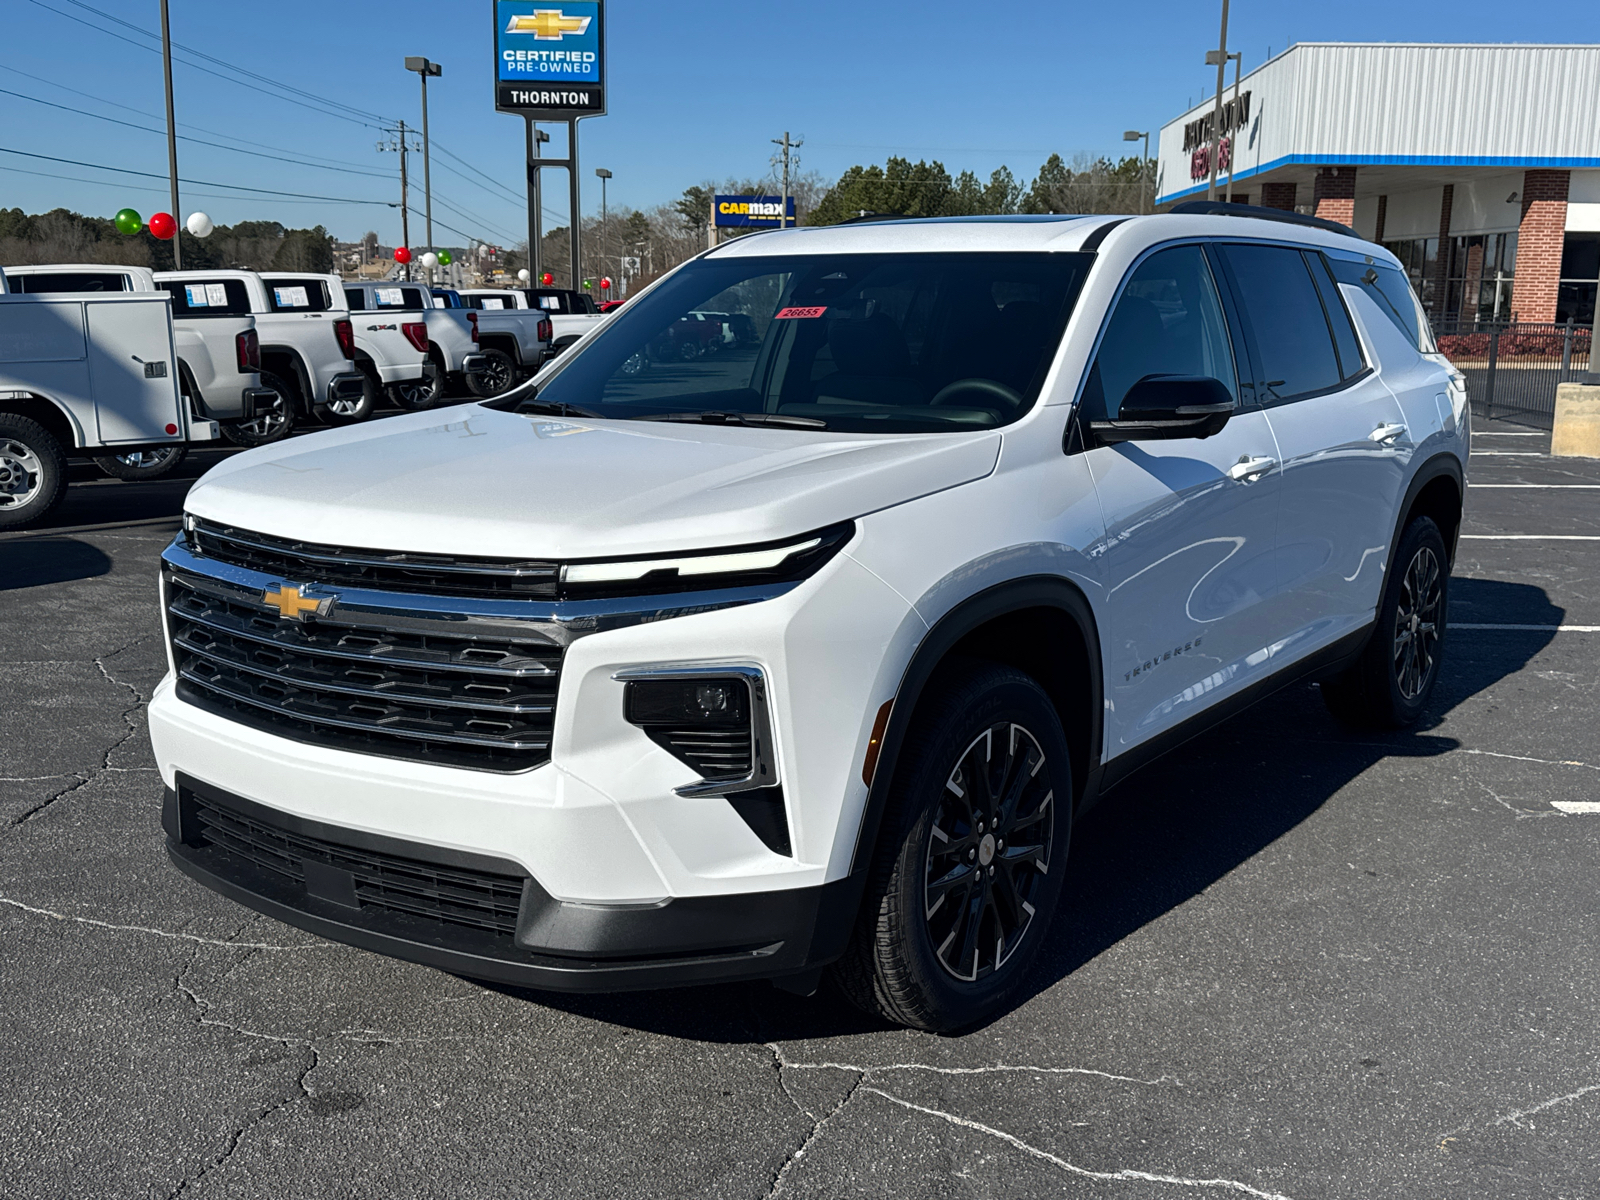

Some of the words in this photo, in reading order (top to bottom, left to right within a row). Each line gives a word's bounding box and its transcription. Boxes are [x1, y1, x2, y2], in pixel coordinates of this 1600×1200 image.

[503, 50, 596, 62] CERTIFIED
[507, 62, 591, 73] PRE-OWNED
[510, 91, 589, 105] THORNTON
[782, 308, 820, 317] 26655
[1124, 637, 1202, 682] TRAVERSE
